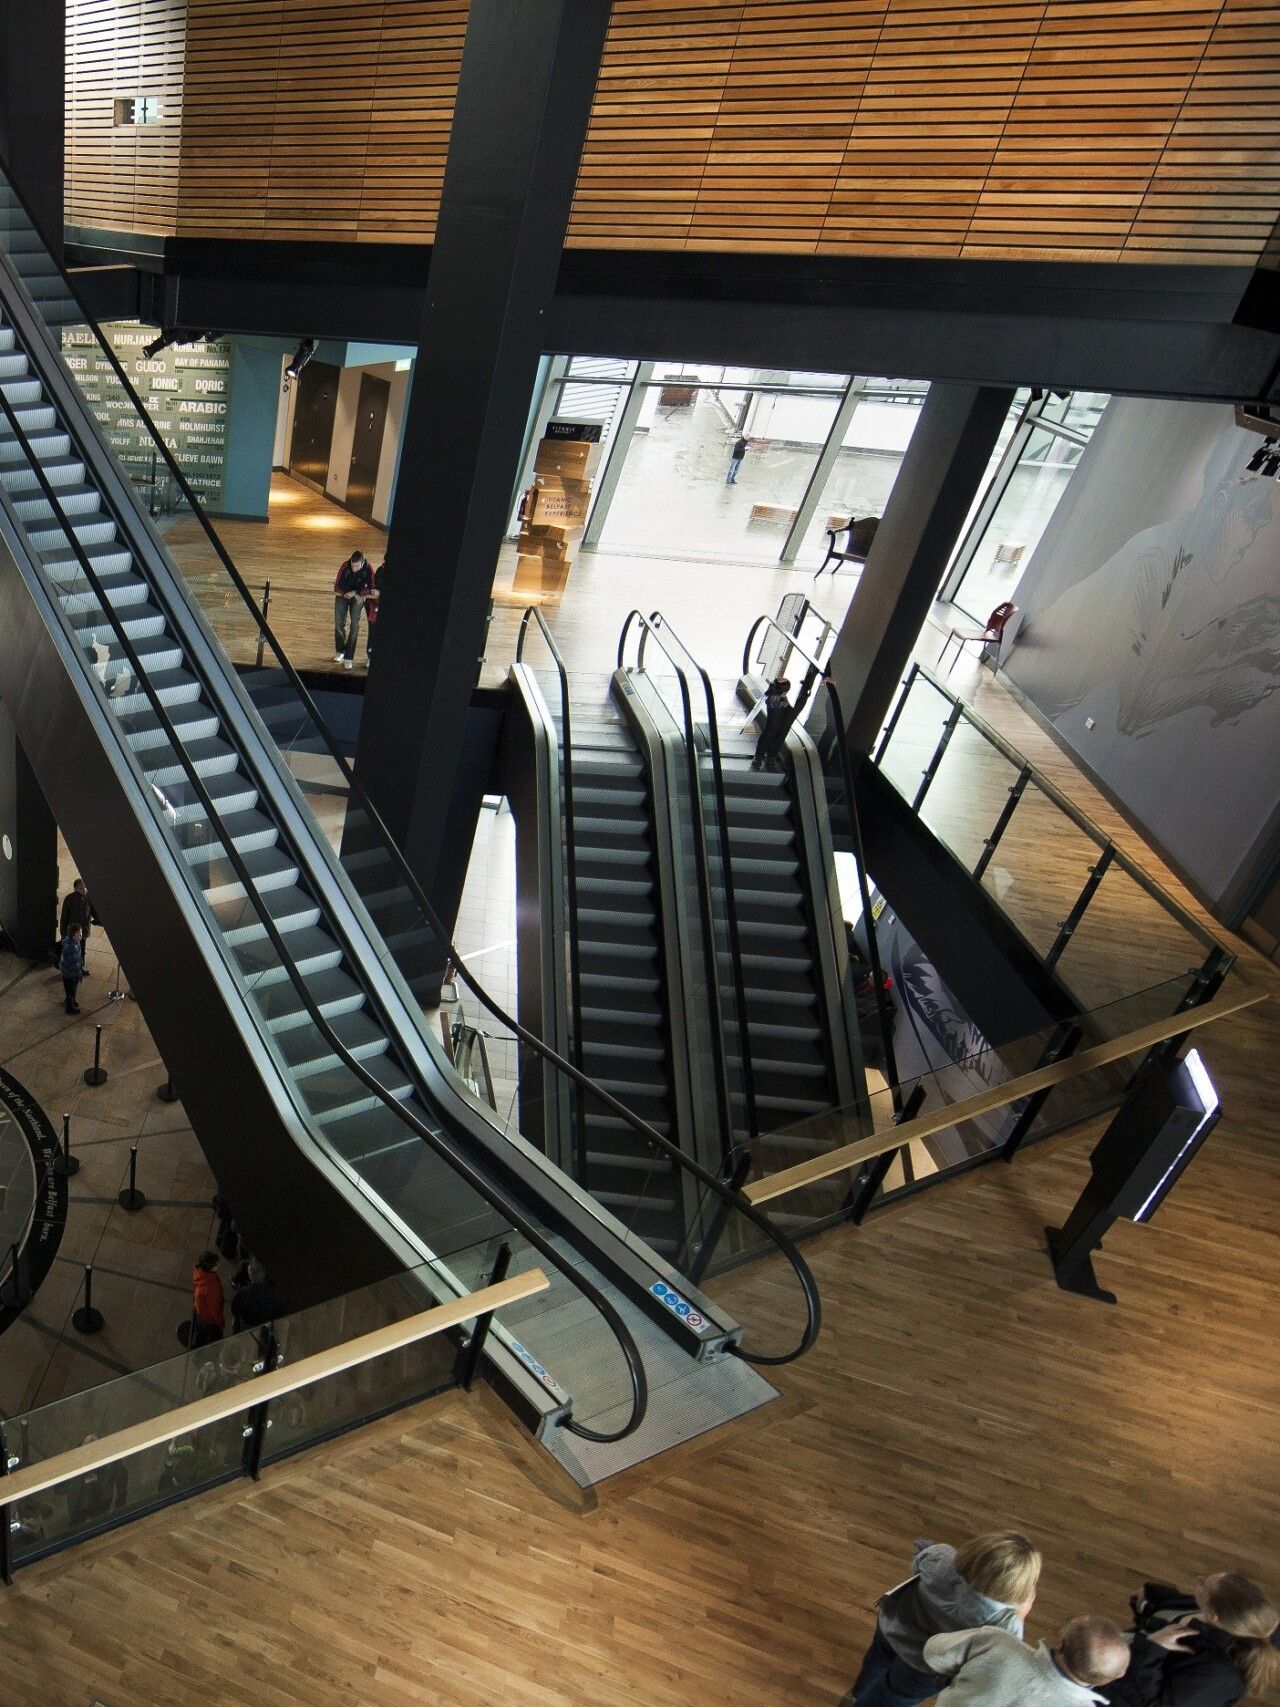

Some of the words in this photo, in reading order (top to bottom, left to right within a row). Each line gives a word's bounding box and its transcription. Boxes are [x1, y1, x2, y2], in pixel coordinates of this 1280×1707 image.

[62, 332, 97, 344] GAELI
[113, 334, 157, 346] NURJAH
[135, 360, 167, 373] GUIDO
[174, 357, 189, 367] BAY
[200, 358, 230, 368] PANAMA
[105, 375, 140, 385] YUCAN
[195, 379, 224, 391] DORIC
[84, 393, 101, 401] KING
[179, 401, 227, 414] ARABIC
[179, 422, 226, 432] HOLMHURST
[200, 455, 224, 464] BAWN
[44, 1190, 58, 1218] Belfast
